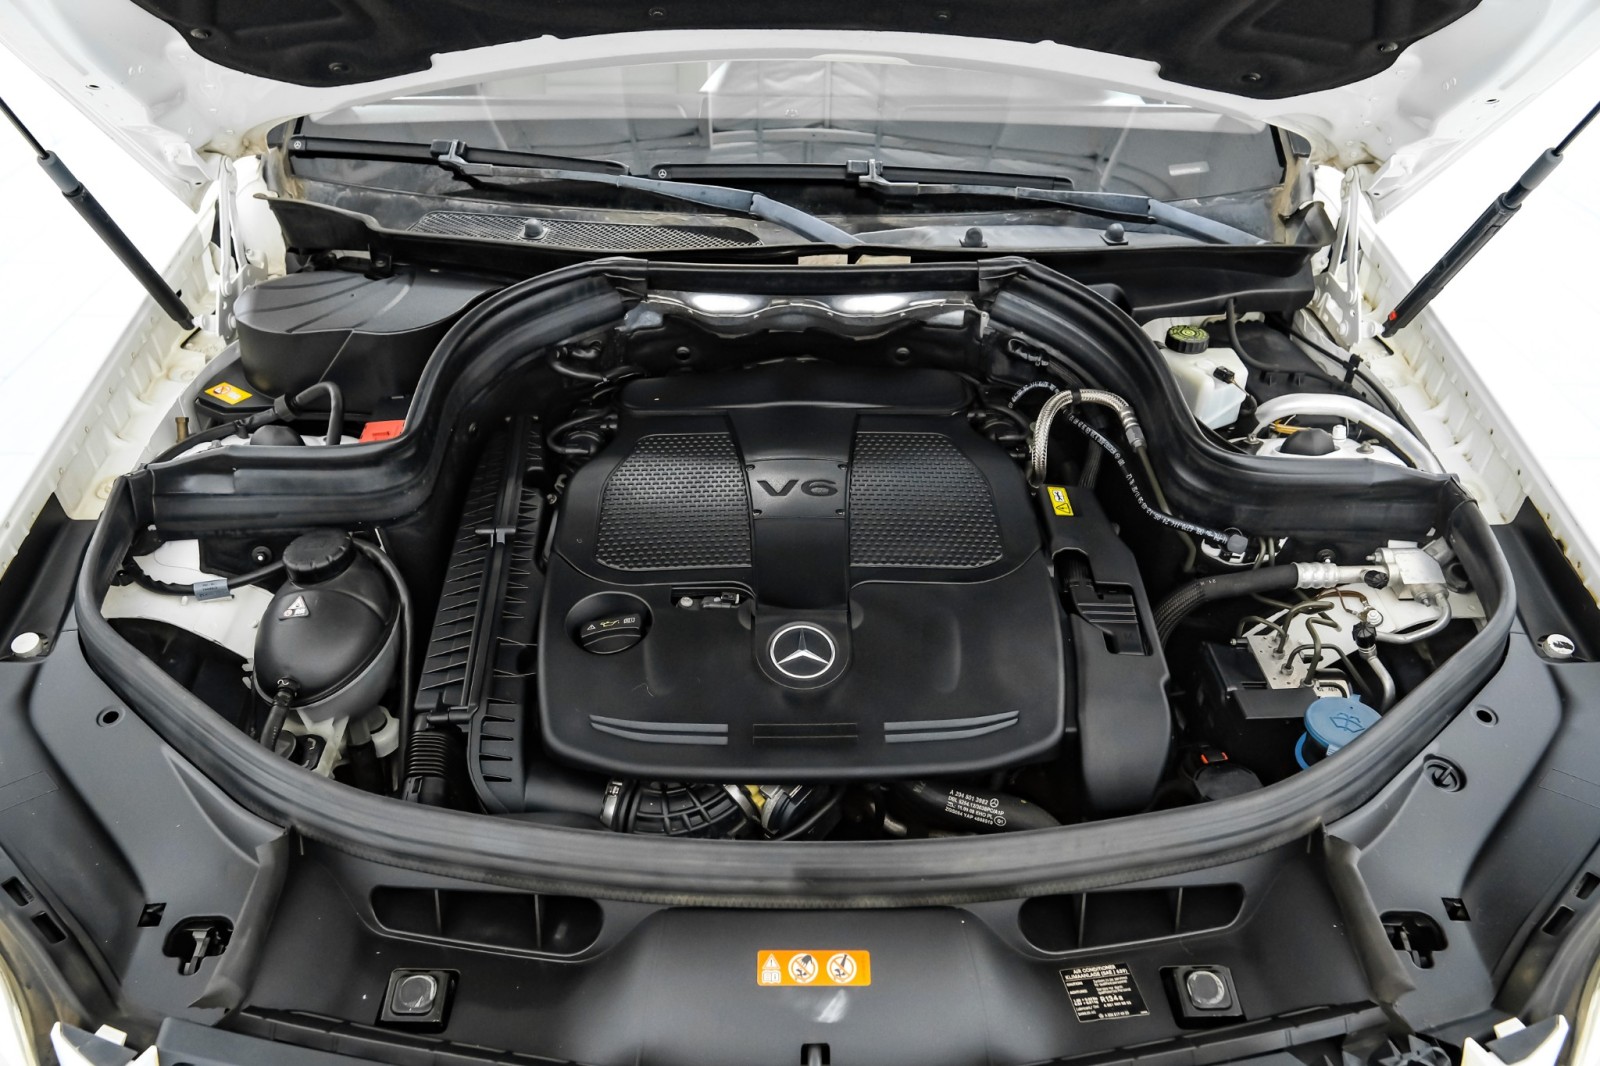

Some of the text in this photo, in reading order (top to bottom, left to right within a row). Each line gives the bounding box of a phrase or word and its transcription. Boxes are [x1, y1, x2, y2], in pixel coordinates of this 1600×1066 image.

[757, 480, 838, 497] V6
[1082, 964, 1116, 973] CONDITIONER
[1065, 971, 1101, 980] KLIMAANLAGE
